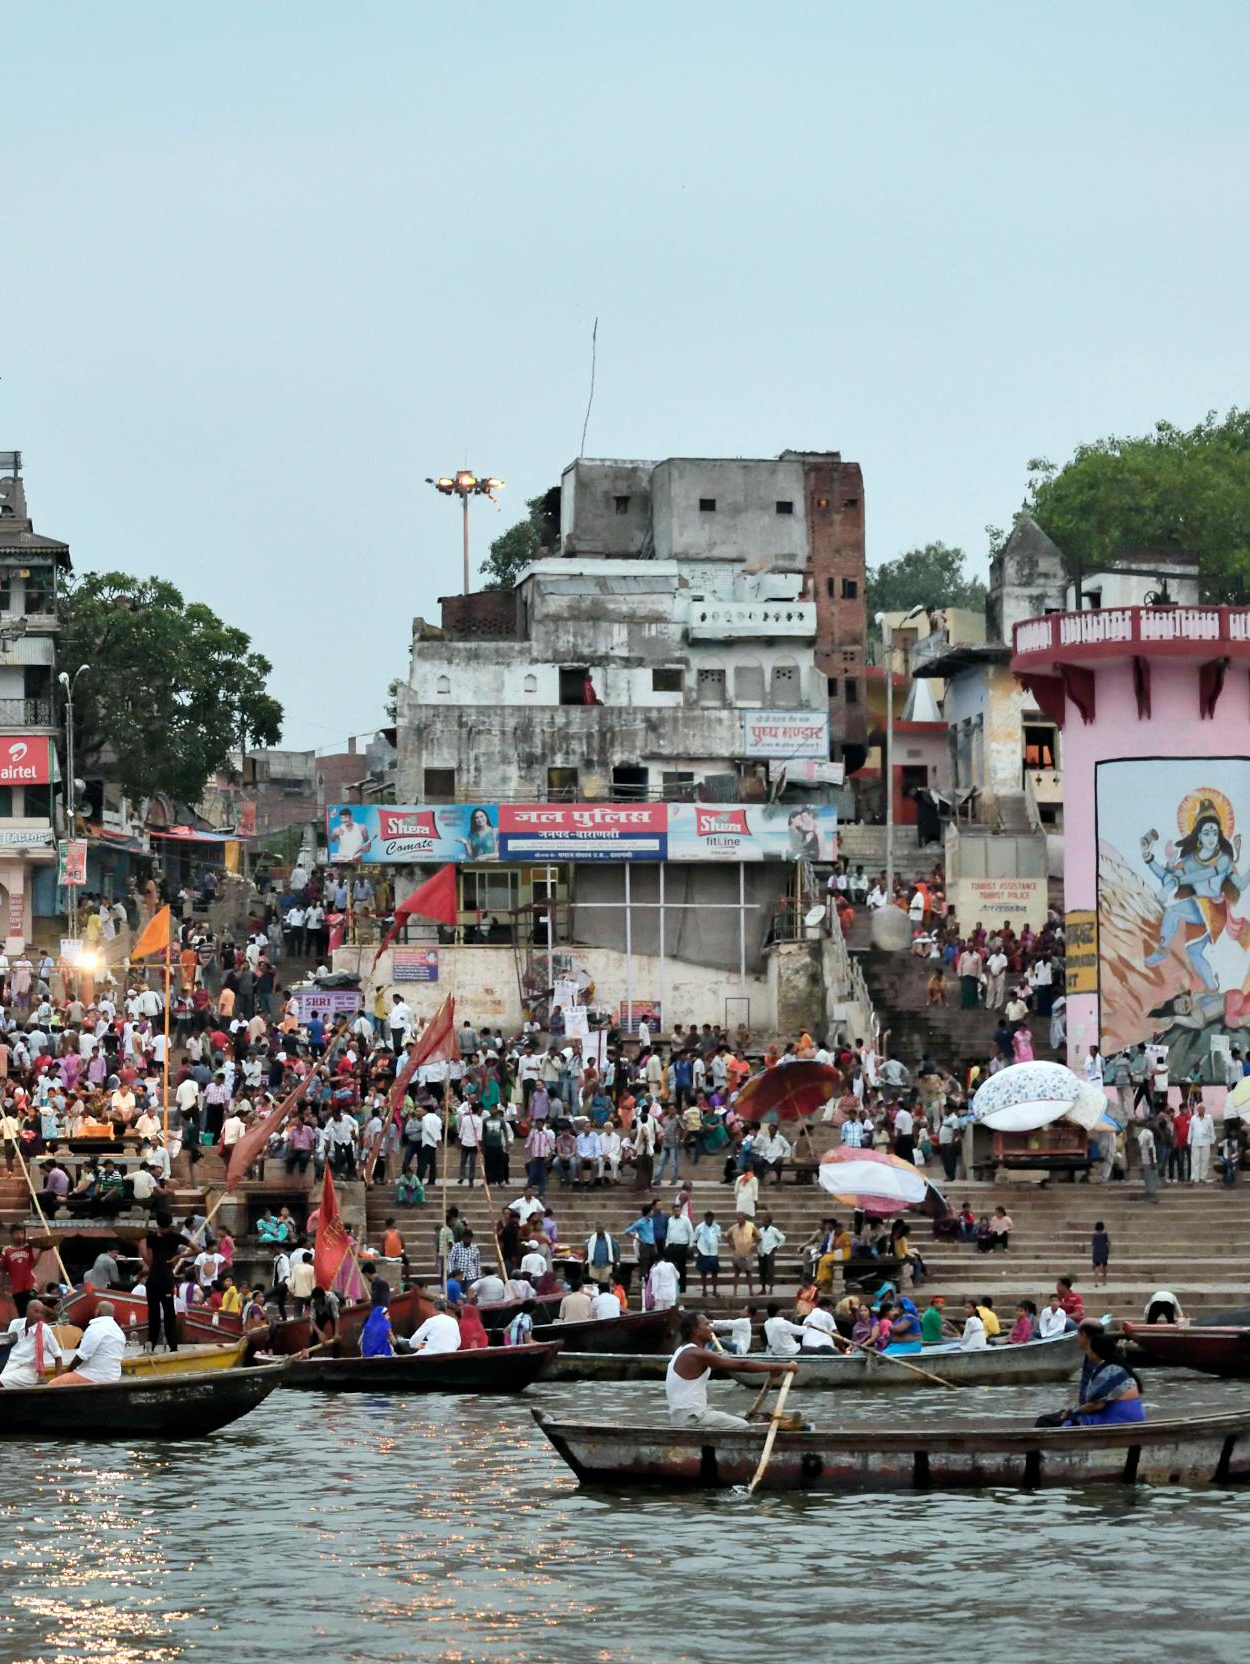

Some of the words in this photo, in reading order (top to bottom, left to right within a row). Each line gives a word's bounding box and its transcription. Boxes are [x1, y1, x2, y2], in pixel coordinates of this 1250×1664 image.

[0, 764, 37, 779] airtel
[514, 811, 566, 823] जल
[572, 808, 652, 827] पुलिस
[387, 817, 429, 834] Shera
[385, 838, 433, 856] Comate
[706, 836, 740, 847] fitLine
[971, 882, 996, 890] TOURIST
[999, 882, 1038, 890] ASSISTANCE
[305, 997, 331, 1006] SHRI
